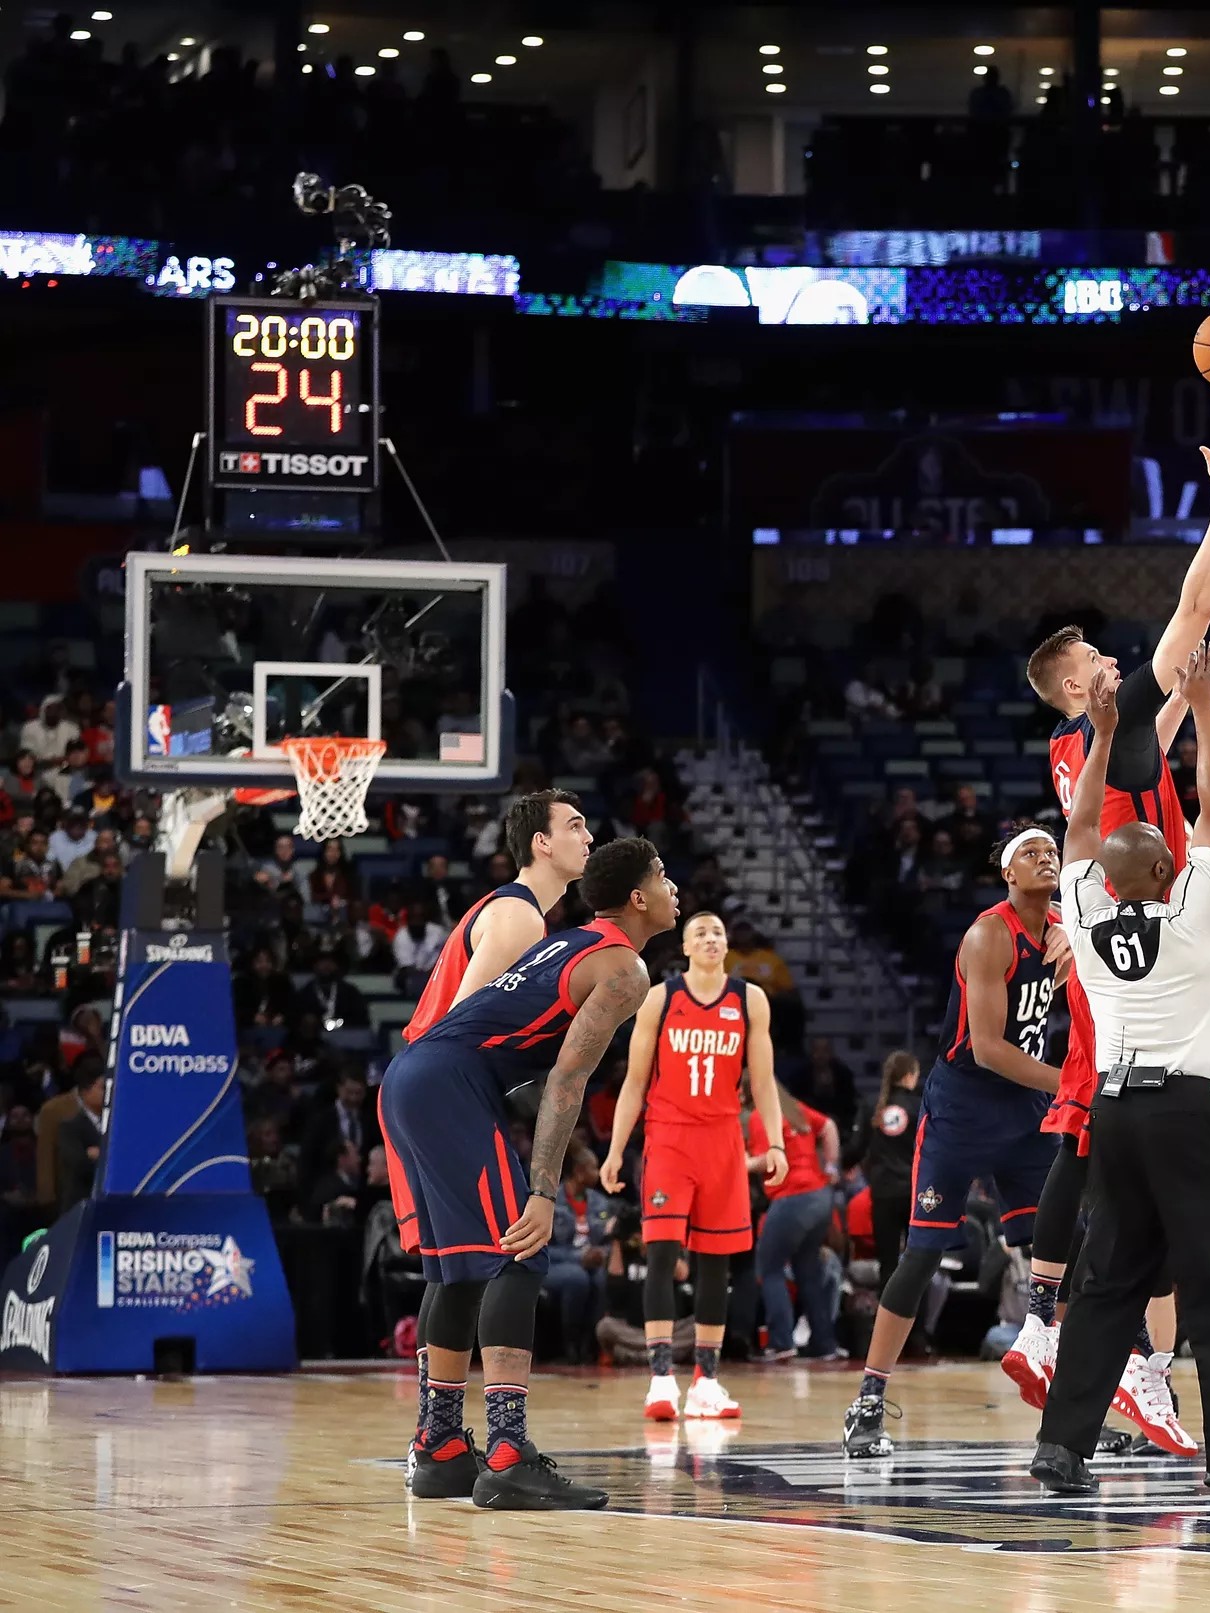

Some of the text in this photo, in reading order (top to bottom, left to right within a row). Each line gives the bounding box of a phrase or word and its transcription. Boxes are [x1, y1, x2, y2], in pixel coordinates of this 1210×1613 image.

[233, 314, 354, 360] 20:00
[245, 362, 342, 436] 24
[262, 454, 369, 477] TISSOT
[145, 944, 214, 964] SPALDING
[1110, 932, 1146, 972] 61
[130, 1024, 190, 1047] BBVA
[668, 1027, 741, 1057] WORLD
[128, 1051, 229, 1078] Compass
[687, 1055, 715, 1097] 11
[117, 1231, 222, 1249] BBVA Compass
[117, 1250, 205, 1273] RISING
[117, 1272, 195, 1294] STARS
[0, 1289, 56, 1365] PALDING
